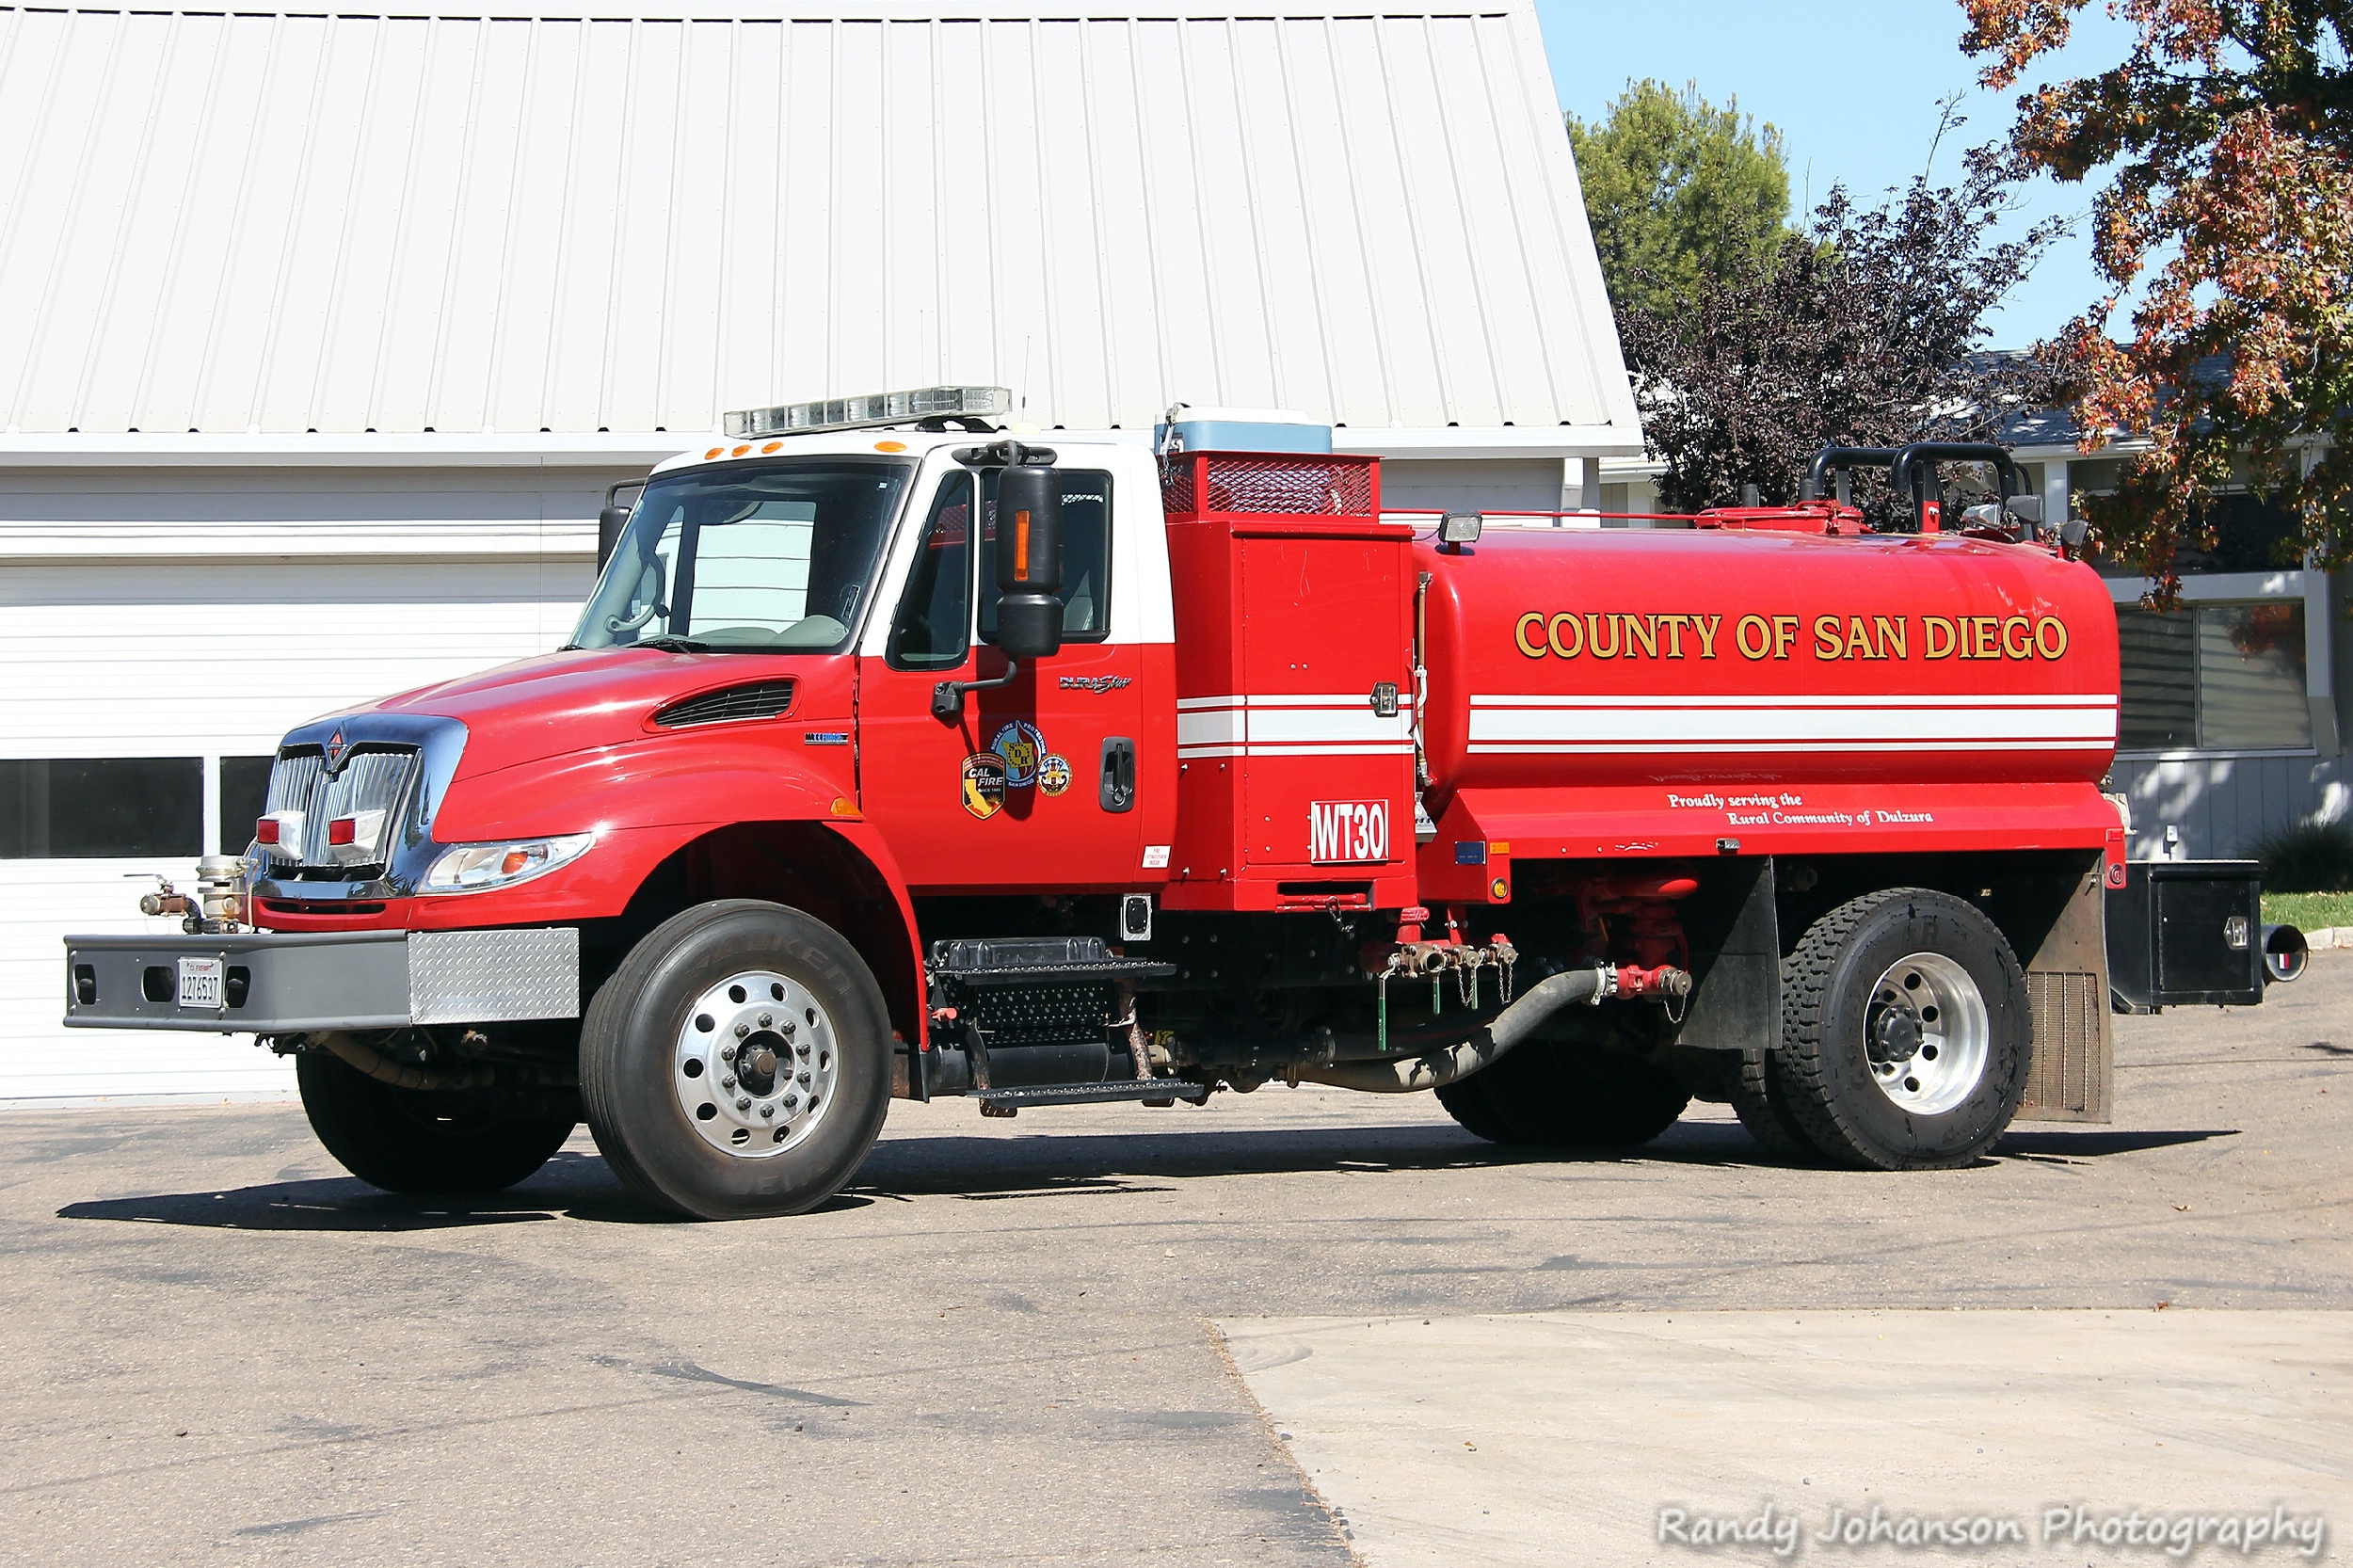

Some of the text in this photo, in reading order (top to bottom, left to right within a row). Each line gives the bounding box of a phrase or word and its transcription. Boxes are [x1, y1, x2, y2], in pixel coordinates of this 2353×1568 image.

[1514, 611, 2069, 660] COUNTY OF SAN DIEGO
[1023, 722, 1047, 754] PROTECTION
[968, 767, 990, 778] CAL
[978, 776, 1003, 787] FIRE
[1667, 792, 1802, 809] Proudly serving the
[1726, 810, 1934, 826] Rural Community of Dulzura
[1317, 803, 1385, 860] WT30
[182, 975, 218, 1000] 1276537
